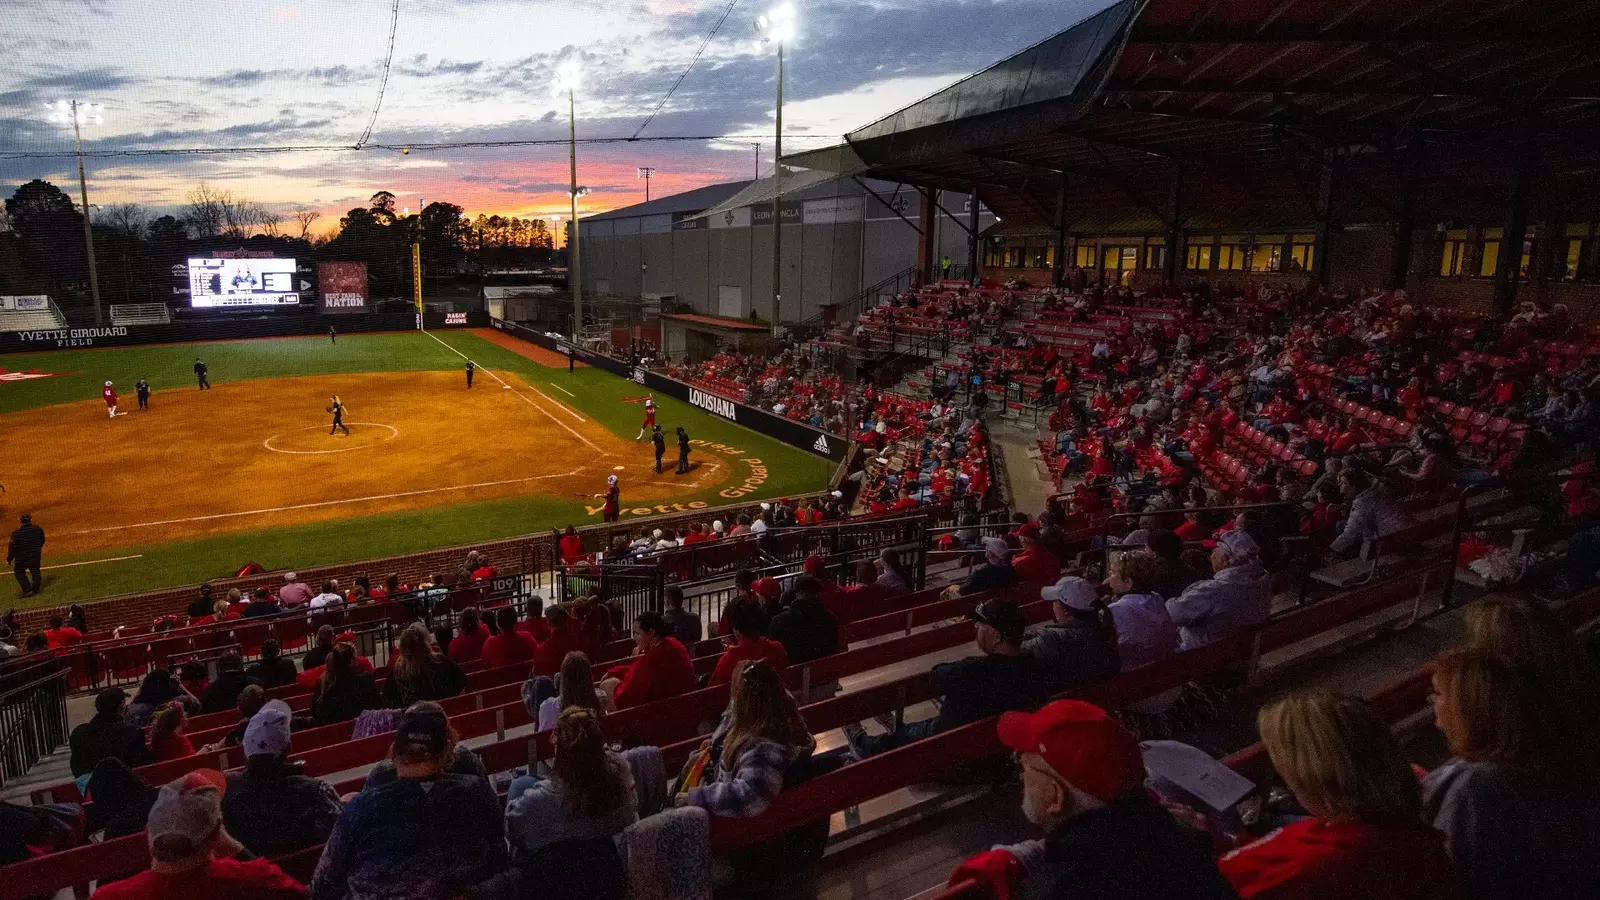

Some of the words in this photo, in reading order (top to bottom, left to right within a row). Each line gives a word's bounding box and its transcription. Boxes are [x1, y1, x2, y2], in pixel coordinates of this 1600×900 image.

[753, 210, 771, 220] LEON
[771, 208, 800, 218] MNCLA
[325, 297, 364, 308] NATION
[18, 329, 68, 341] YVETTE
[70, 326, 128, 338] GIROUARD
[57, 338, 93, 347] FIELD
[688, 387, 737, 421] LOUISIANA
[813, 443, 831, 455] adidas
[719, 457, 769, 498] Girouard
[492, 578, 514, 591] 109
